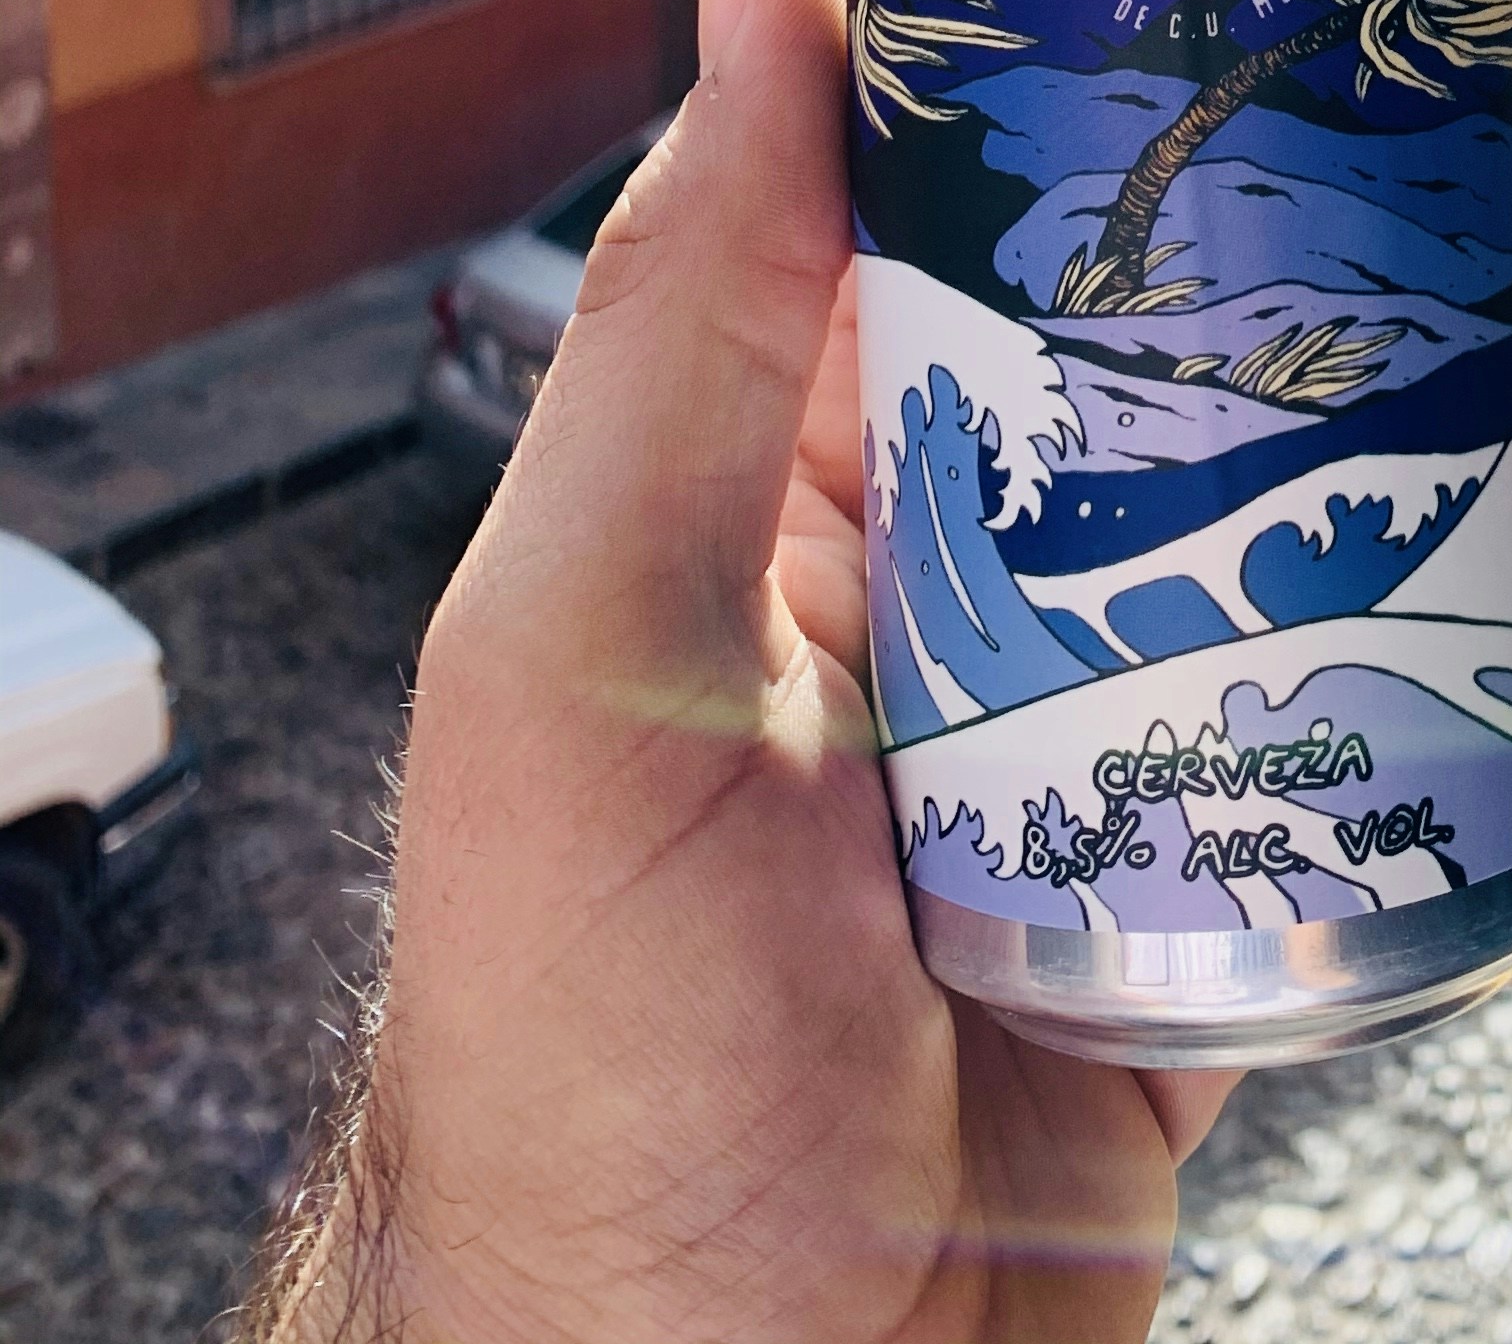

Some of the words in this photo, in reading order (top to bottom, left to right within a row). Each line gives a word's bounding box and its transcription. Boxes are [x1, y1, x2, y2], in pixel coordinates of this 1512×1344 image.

[1094, 733, 1373, 803] CERVEZA
[1183, 825, 1309, 879] ALC.
[1335, 798, 1454, 864] VOL.
